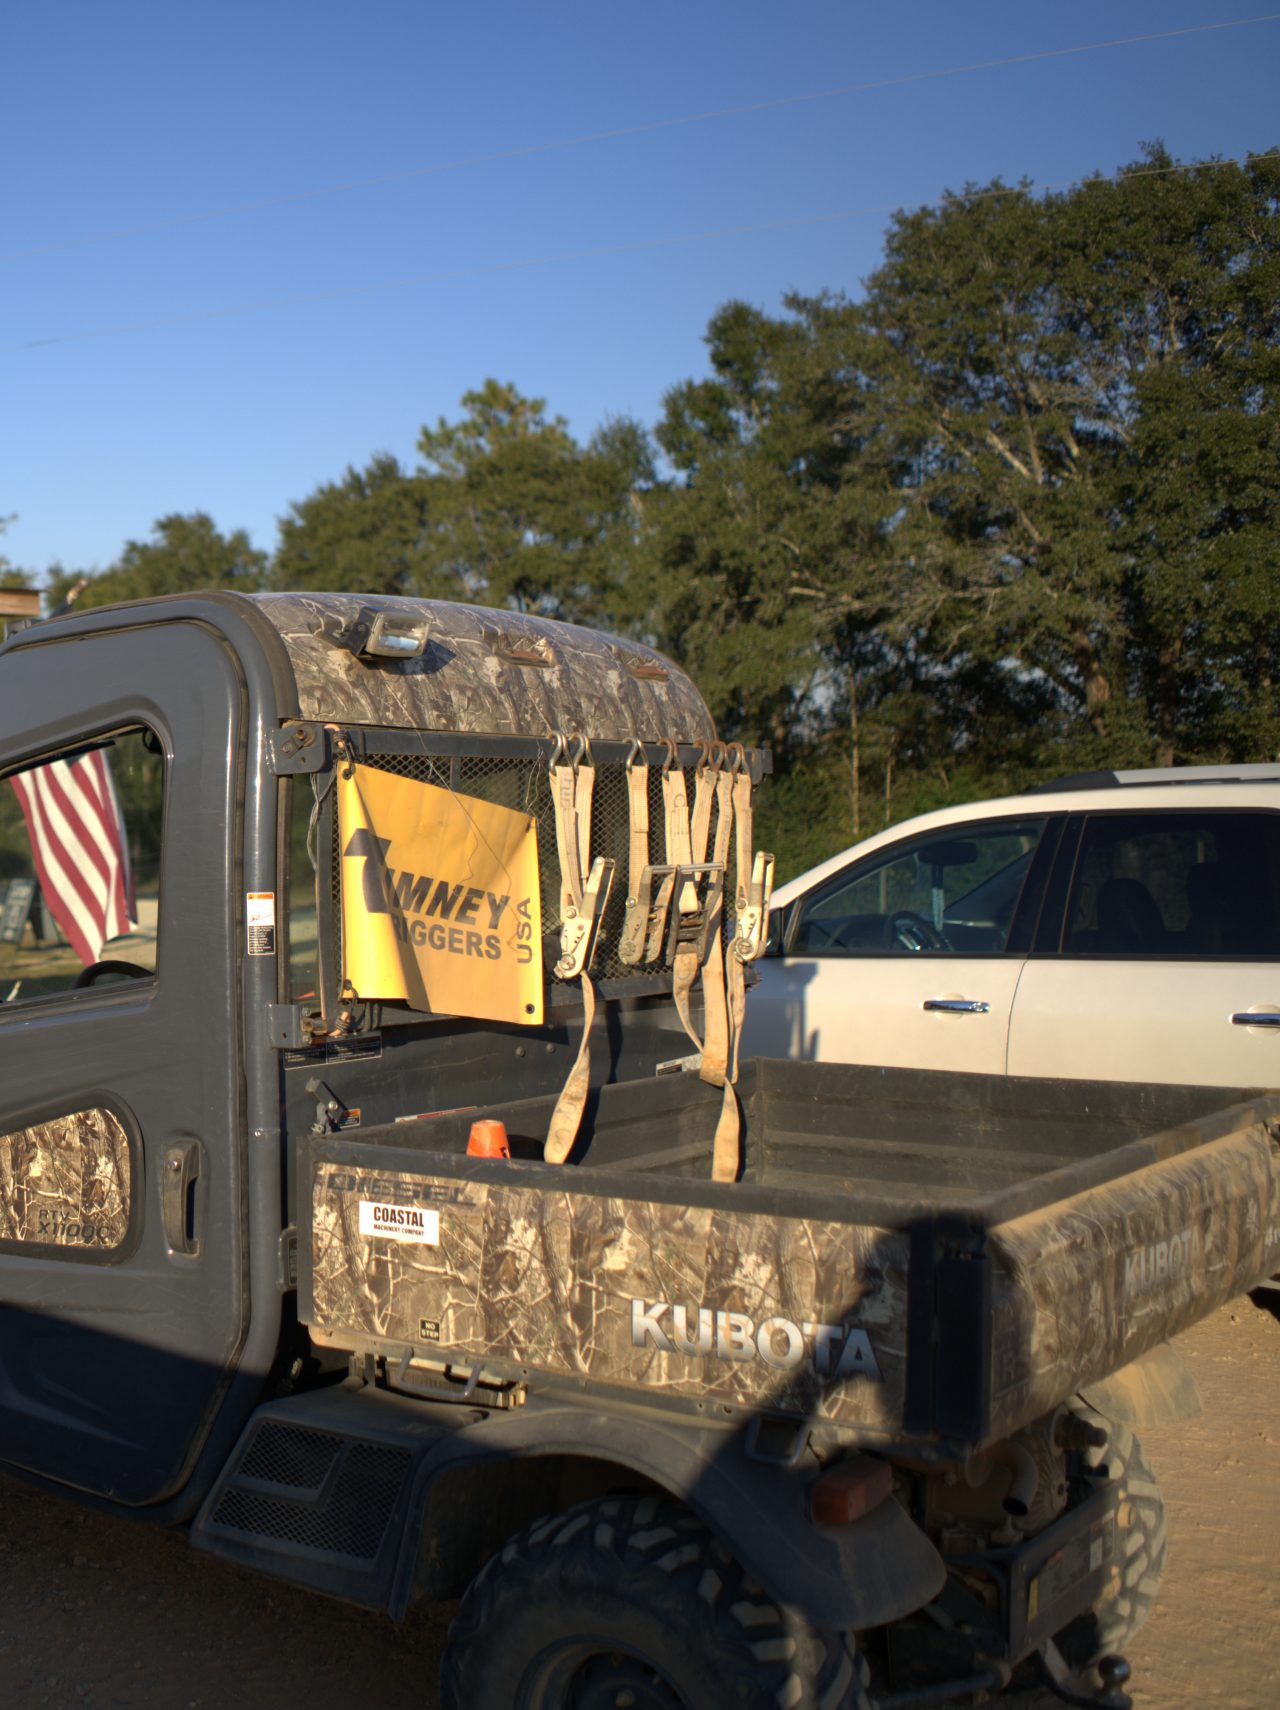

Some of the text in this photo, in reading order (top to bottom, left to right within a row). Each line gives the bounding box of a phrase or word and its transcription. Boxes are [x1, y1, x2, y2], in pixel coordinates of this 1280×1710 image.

[516, 897, 533, 964] USA
[373, 1205, 424, 1228] COASTAL
[373, 1223, 424, 1237] MACHINERY COMPANY
[421, 1328, 439, 1339] STEP
[425, 1321, 436, 1331] NO
[631, 1298, 883, 1383] KUBOTA
